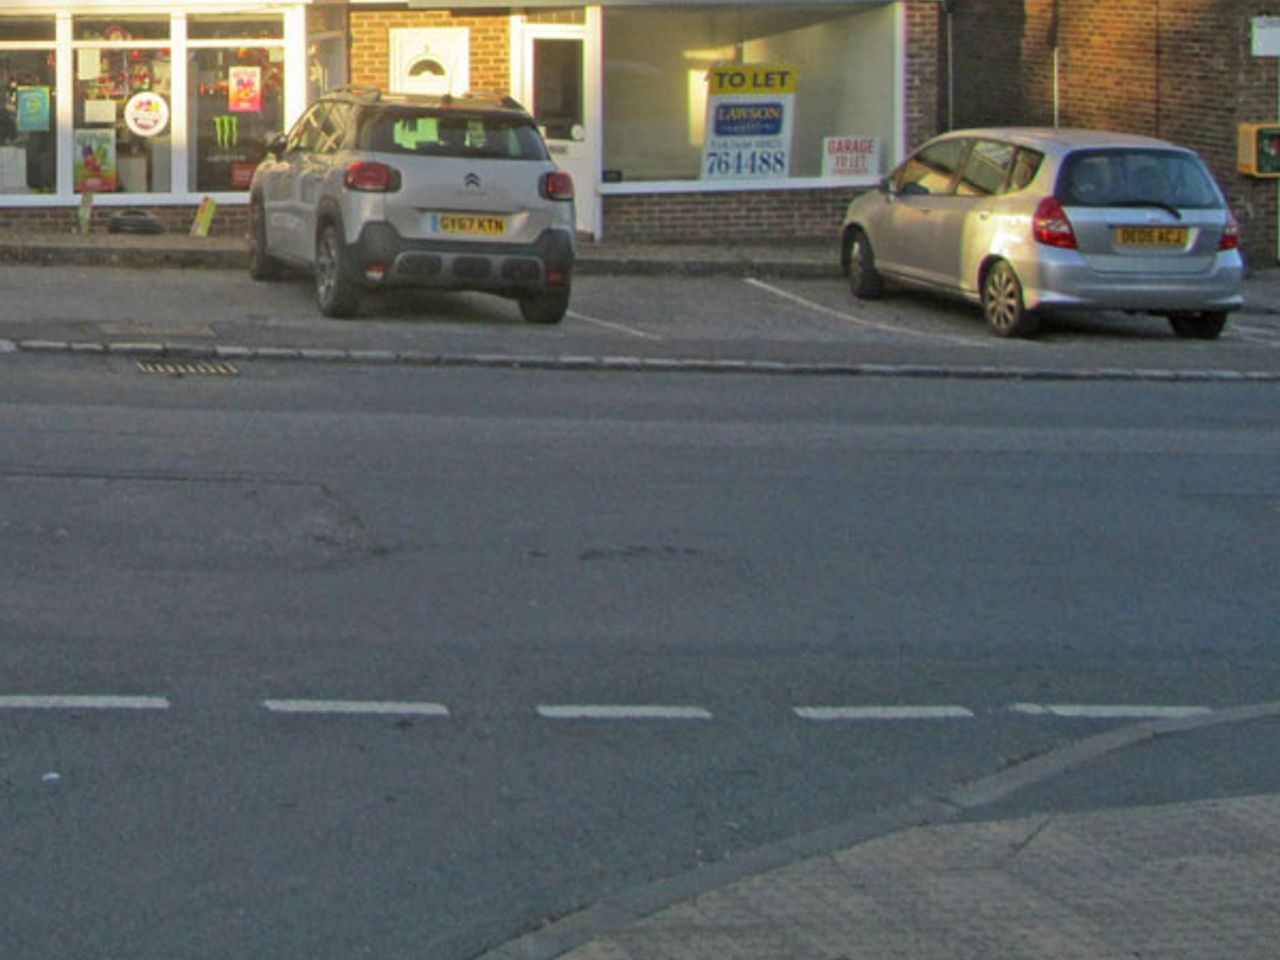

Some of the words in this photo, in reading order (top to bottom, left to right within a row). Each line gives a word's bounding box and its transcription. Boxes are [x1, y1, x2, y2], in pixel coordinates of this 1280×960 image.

[715, 72, 746, 89] TO
[753, 70, 790, 88] LET
[718, 107, 780, 120] LAWSON
[827, 138, 875, 155] GARAGE
[708, 151, 785, 175] 764488
[835, 155, 848, 167] TO
[849, 155, 865, 167] LET
